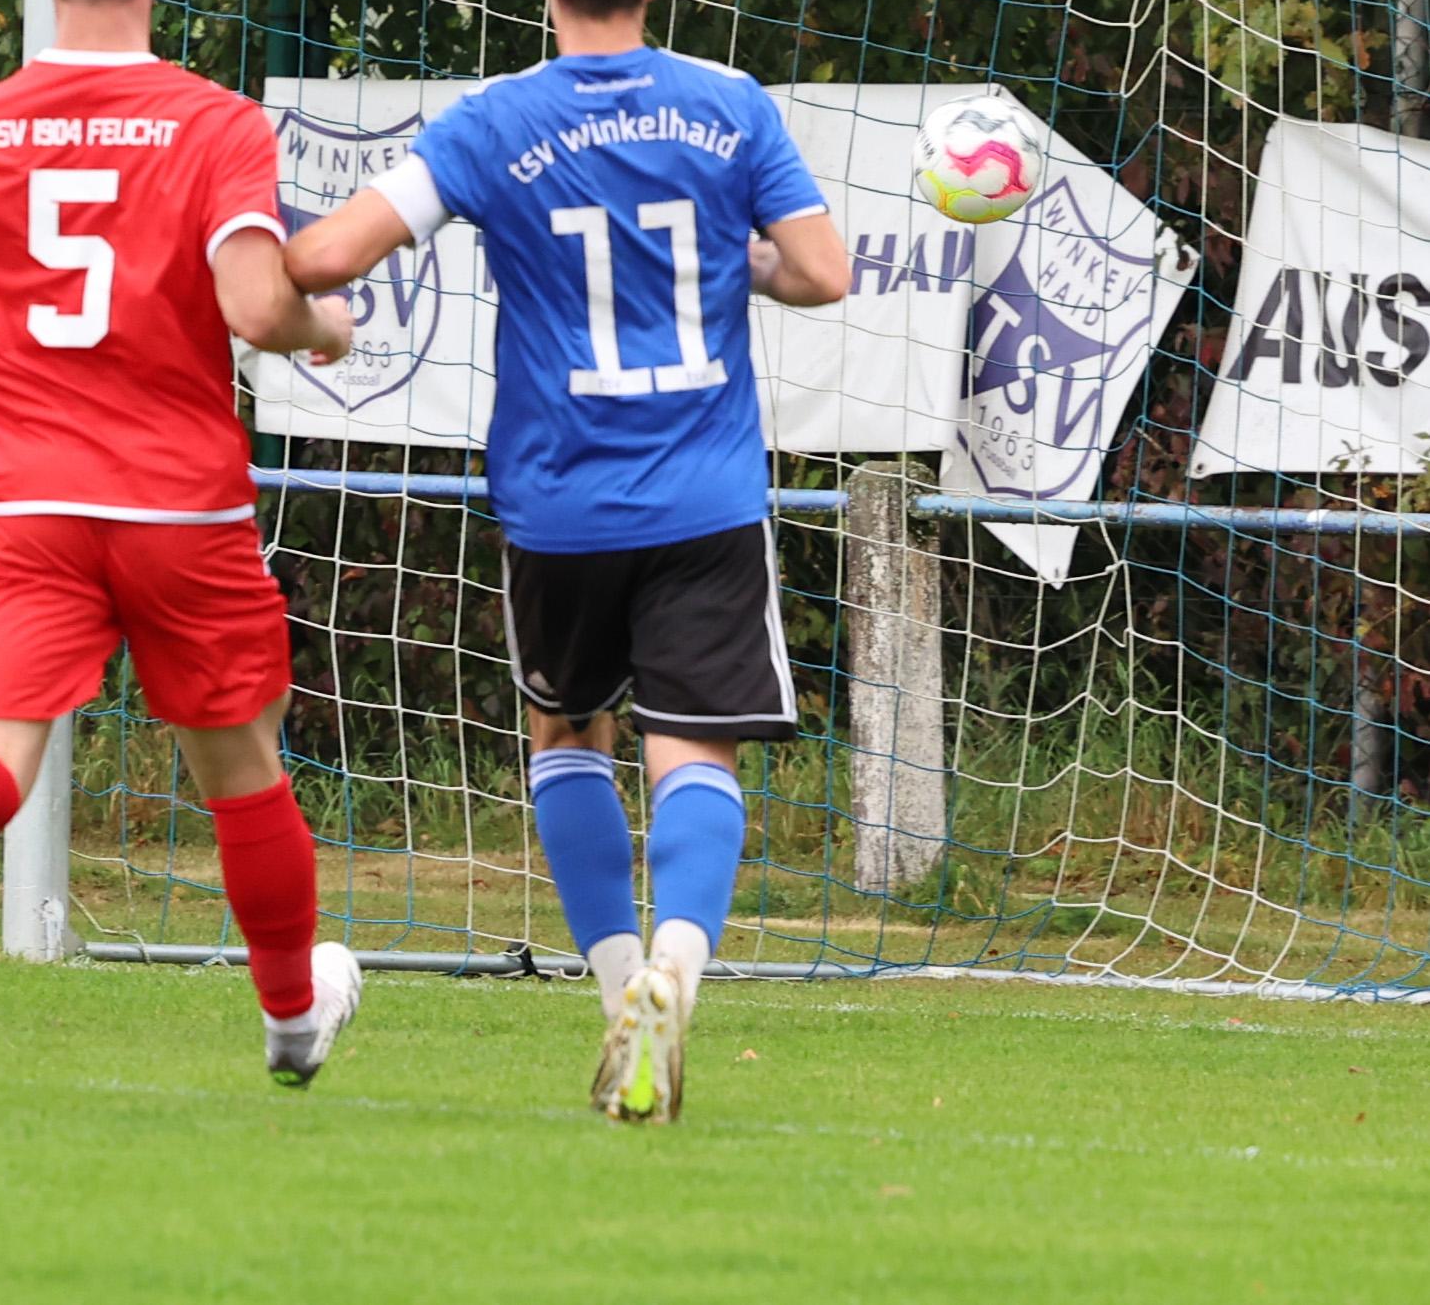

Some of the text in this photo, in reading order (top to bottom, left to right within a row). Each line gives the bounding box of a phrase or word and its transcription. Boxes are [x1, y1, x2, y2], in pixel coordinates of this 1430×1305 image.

[86, 118, 179, 147] FEUCHT
[508, 106, 743, 184] tsv winkelhaid
[27, 169, 119, 348] 5
[549, 199, 728, 396] 11
[1039, 260, 1101, 326] HAID
[973, 294, 1102, 449] TSV
[1226, 268, 1430, 388] AUS
